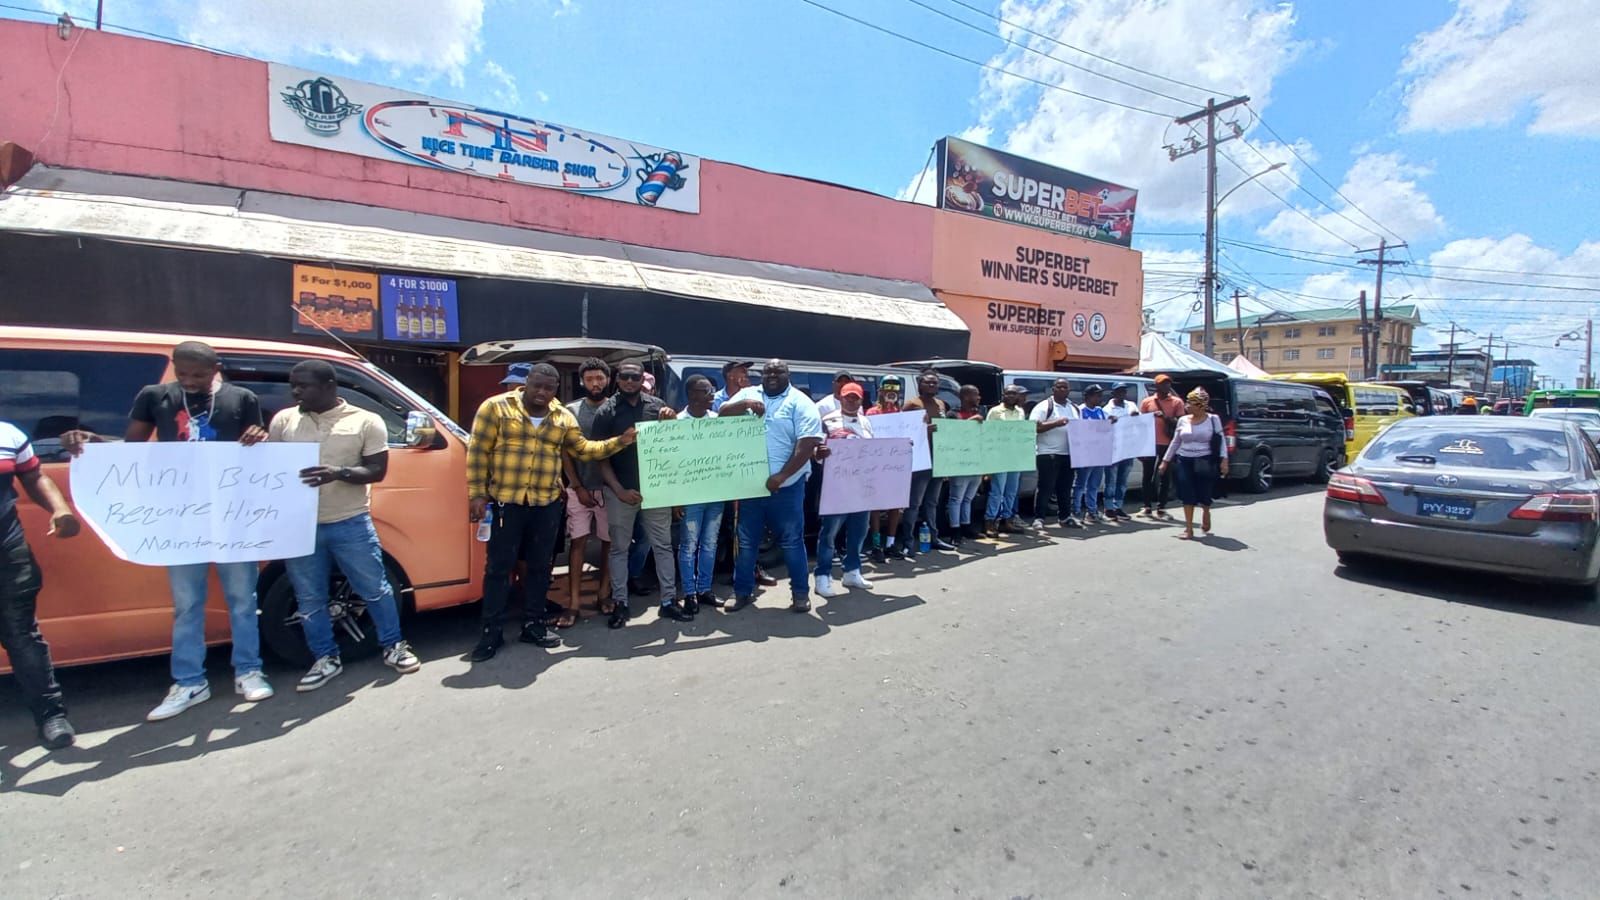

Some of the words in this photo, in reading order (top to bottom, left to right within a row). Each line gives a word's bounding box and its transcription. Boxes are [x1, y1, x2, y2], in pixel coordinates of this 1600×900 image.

[421, 136, 456, 156] NICE
[460, 143, 494, 161] TIME
[499, 150, 559, 173] BARBER
[564, 162, 597, 178] SHOP
[992, 170, 1103, 219] SUPERBET
[1003, 208, 1089, 235] WWW.SUPERBET.GY
[1020, 203, 1041, 214] YOUR
[1042, 208, 1061, 220] BEST
[1016, 246, 1090, 274] SUPERBET
[301, 275, 308, 283] 5
[312, 276, 330, 285] For
[334, 278, 372, 290] $1,000
[390, 278, 396, 288] 4
[399, 279, 417, 289] FOR
[420, 280, 448, 292] $1000
[981, 259, 1049, 286] WINNER'S
[1053, 271, 1119, 297] SUPERBET
[987, 302, 1066, 327] SUPERBET
[988, 321, 1062, 337] WWW.SUPERBET.GY
[96, 462, 188, 495] Mini
[218, 466, 288, 491] Bus
[105, 502, 213, 526] Require
[223, 499, 280, 528] High
[1423, 503, 1444, 513] PYY
[1445, 505, 1472, 515] 3227
